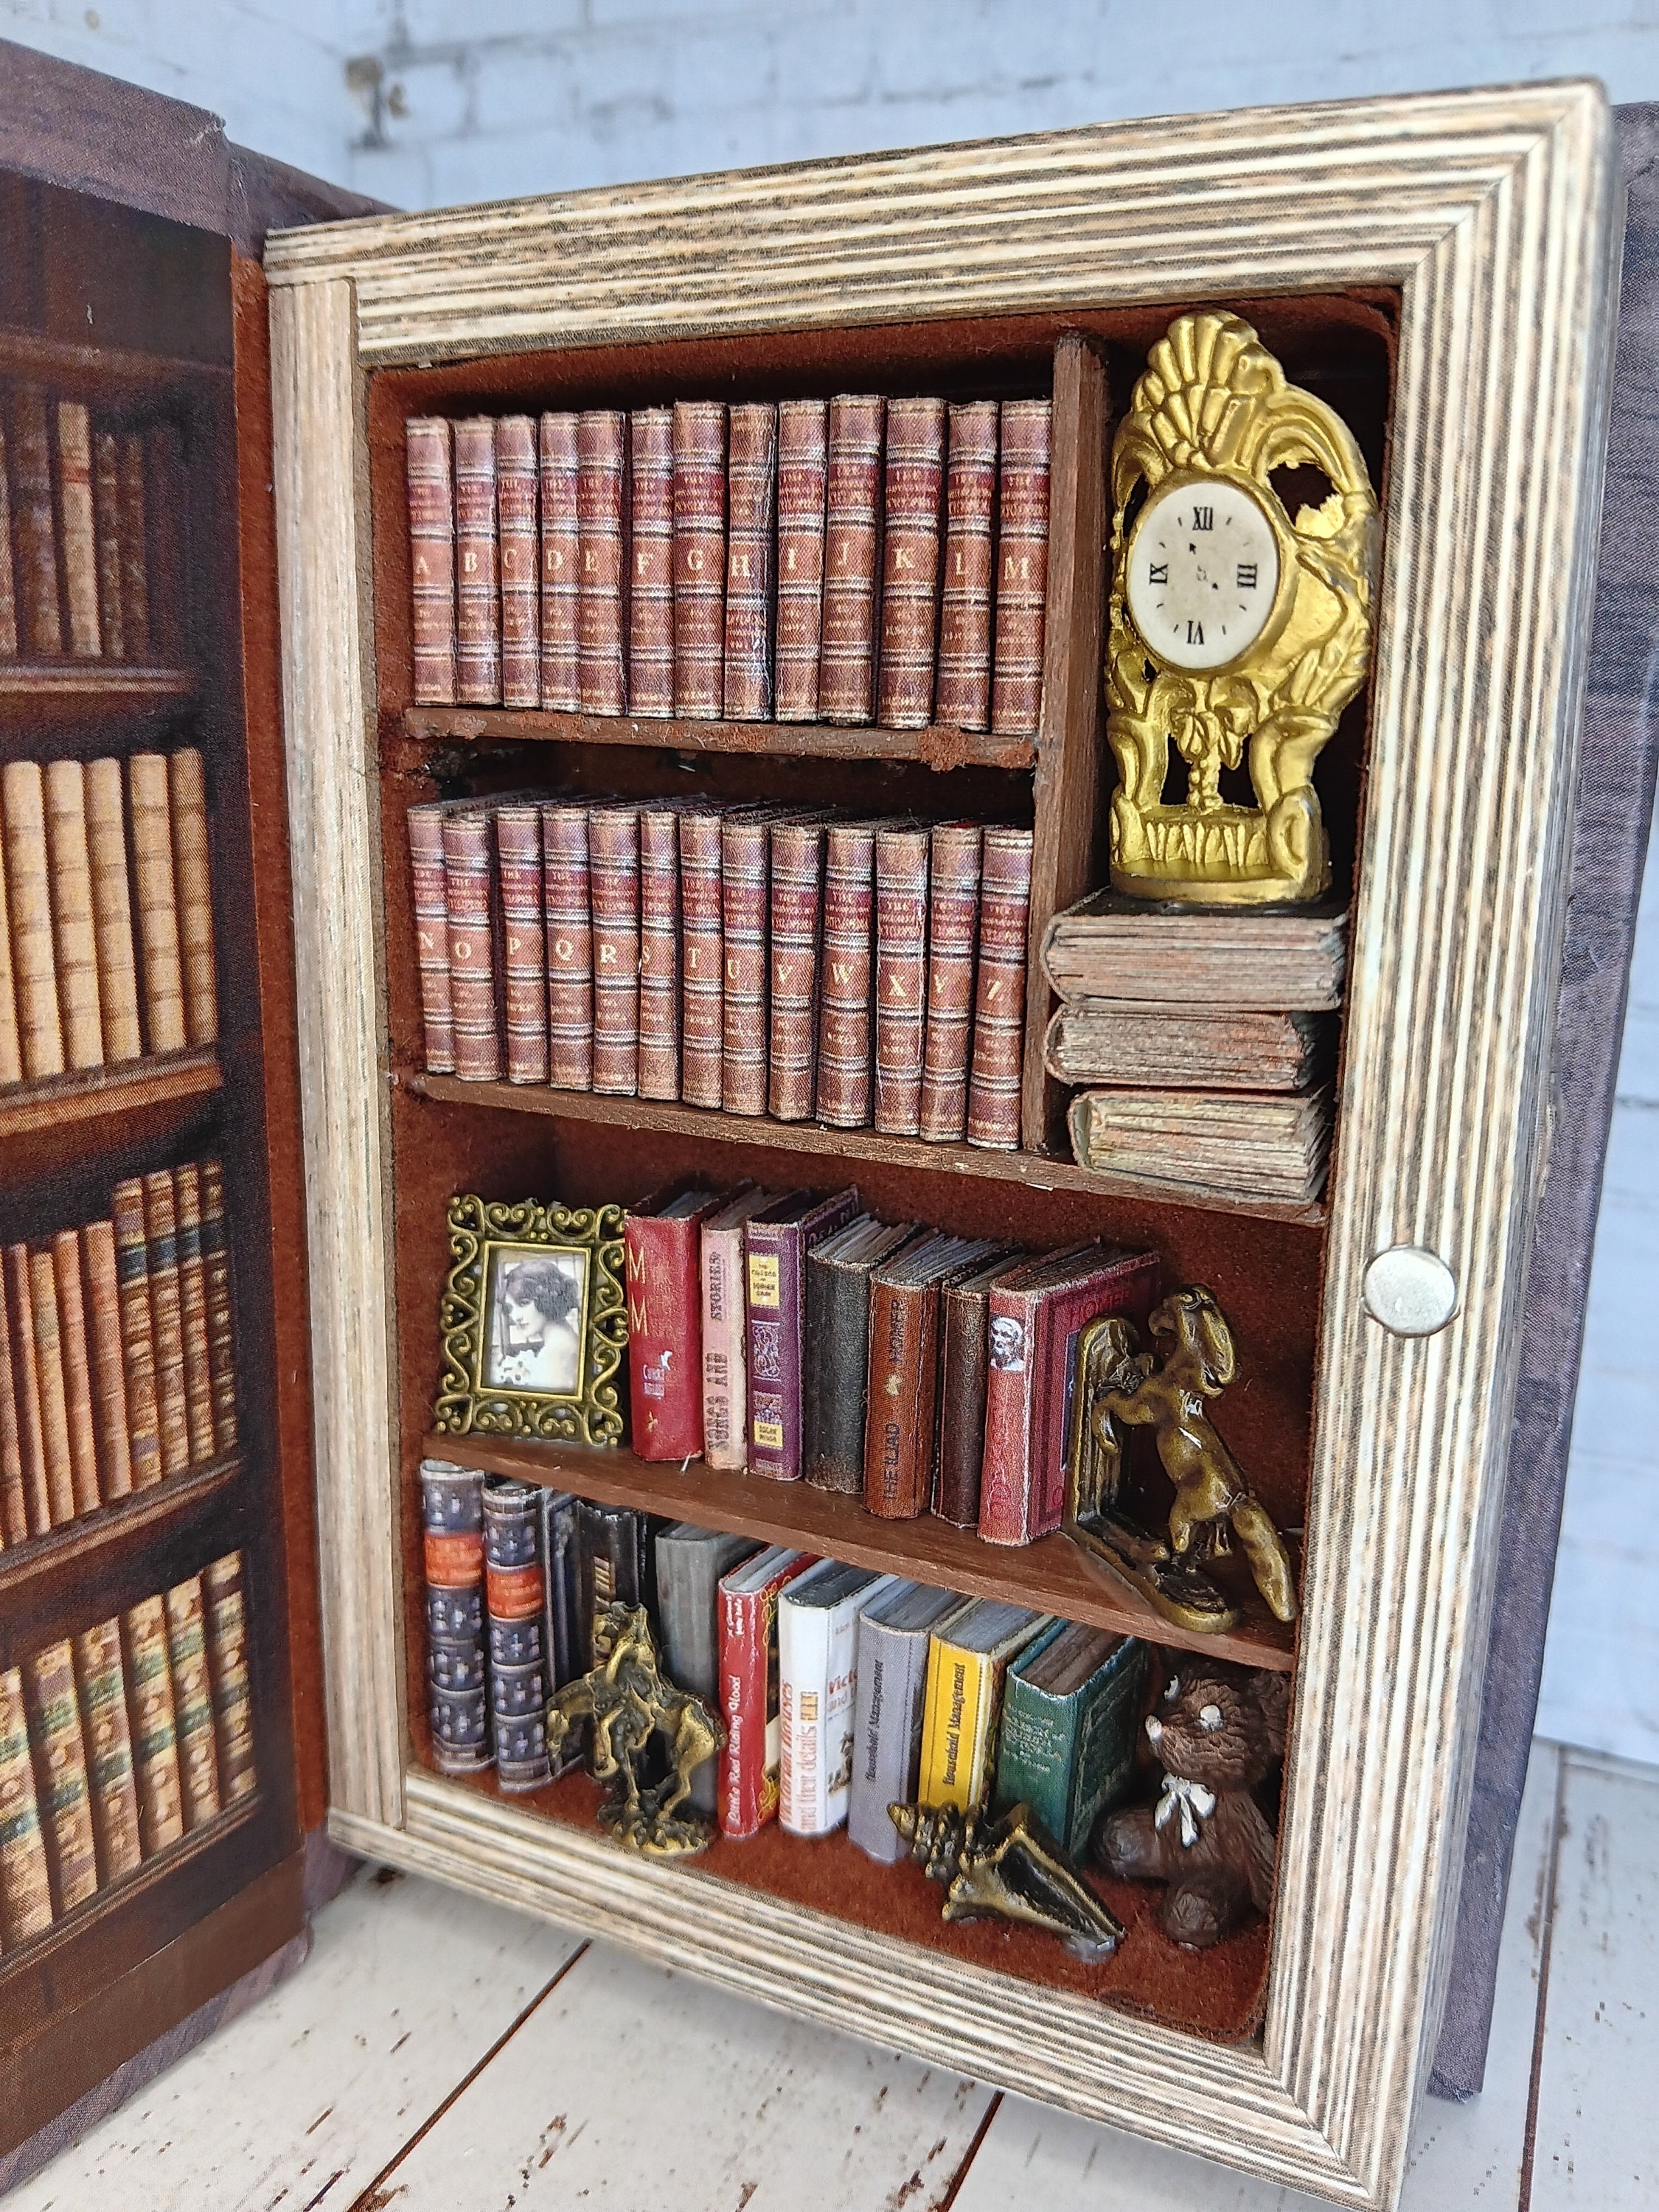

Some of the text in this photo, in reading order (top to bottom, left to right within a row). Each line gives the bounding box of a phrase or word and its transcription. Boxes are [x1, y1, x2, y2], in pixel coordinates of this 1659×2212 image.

[1192, 507, 1213, 531] XII
[465, 552, 478, 572] B
[504, 549, 517, 568] C
[548, 550, 563, 571] D
[585, 550, 598, 571] E
[637, 552, 653, 576] F
[688, 549, 703, 571] G
[787, 548, 797, 571] I
[838, 541, 849, 566] J
[892, 548, 915, 568] K
[956, 552, 969, 575] L
[416, 556, 430, 574] A
[731, 553, 751, 577] H
[1004, 556, 1029, 580] M
[1149, 563, 1169, 586] IX
[1237, 563, 1257, 590] III
[1186, 620, 1205, 645] VI
[418, 931, 434, 950] N
[456, 942, 472, 959] O
[508, 937, 521, 955] P
[555, 939, 574, 961] Q
[599, 944, 617, 964] R
[642, 946, 650, 964] S
[688, 948, 701, 968] T
[727, 959, 740, 979] U
[777, 964, 793, 984] V
[832, 963, 854, 985] W
[889, 975, 907, 996] X
[628, 1241, 645, 1284] M
[709, 1251, 723, 1321] STORIES
[631, 1293, 648, 1337] M
[728, 1675, 743, 1825] Little Red Riding Hood
[796, 1726, 817, 1770] details
